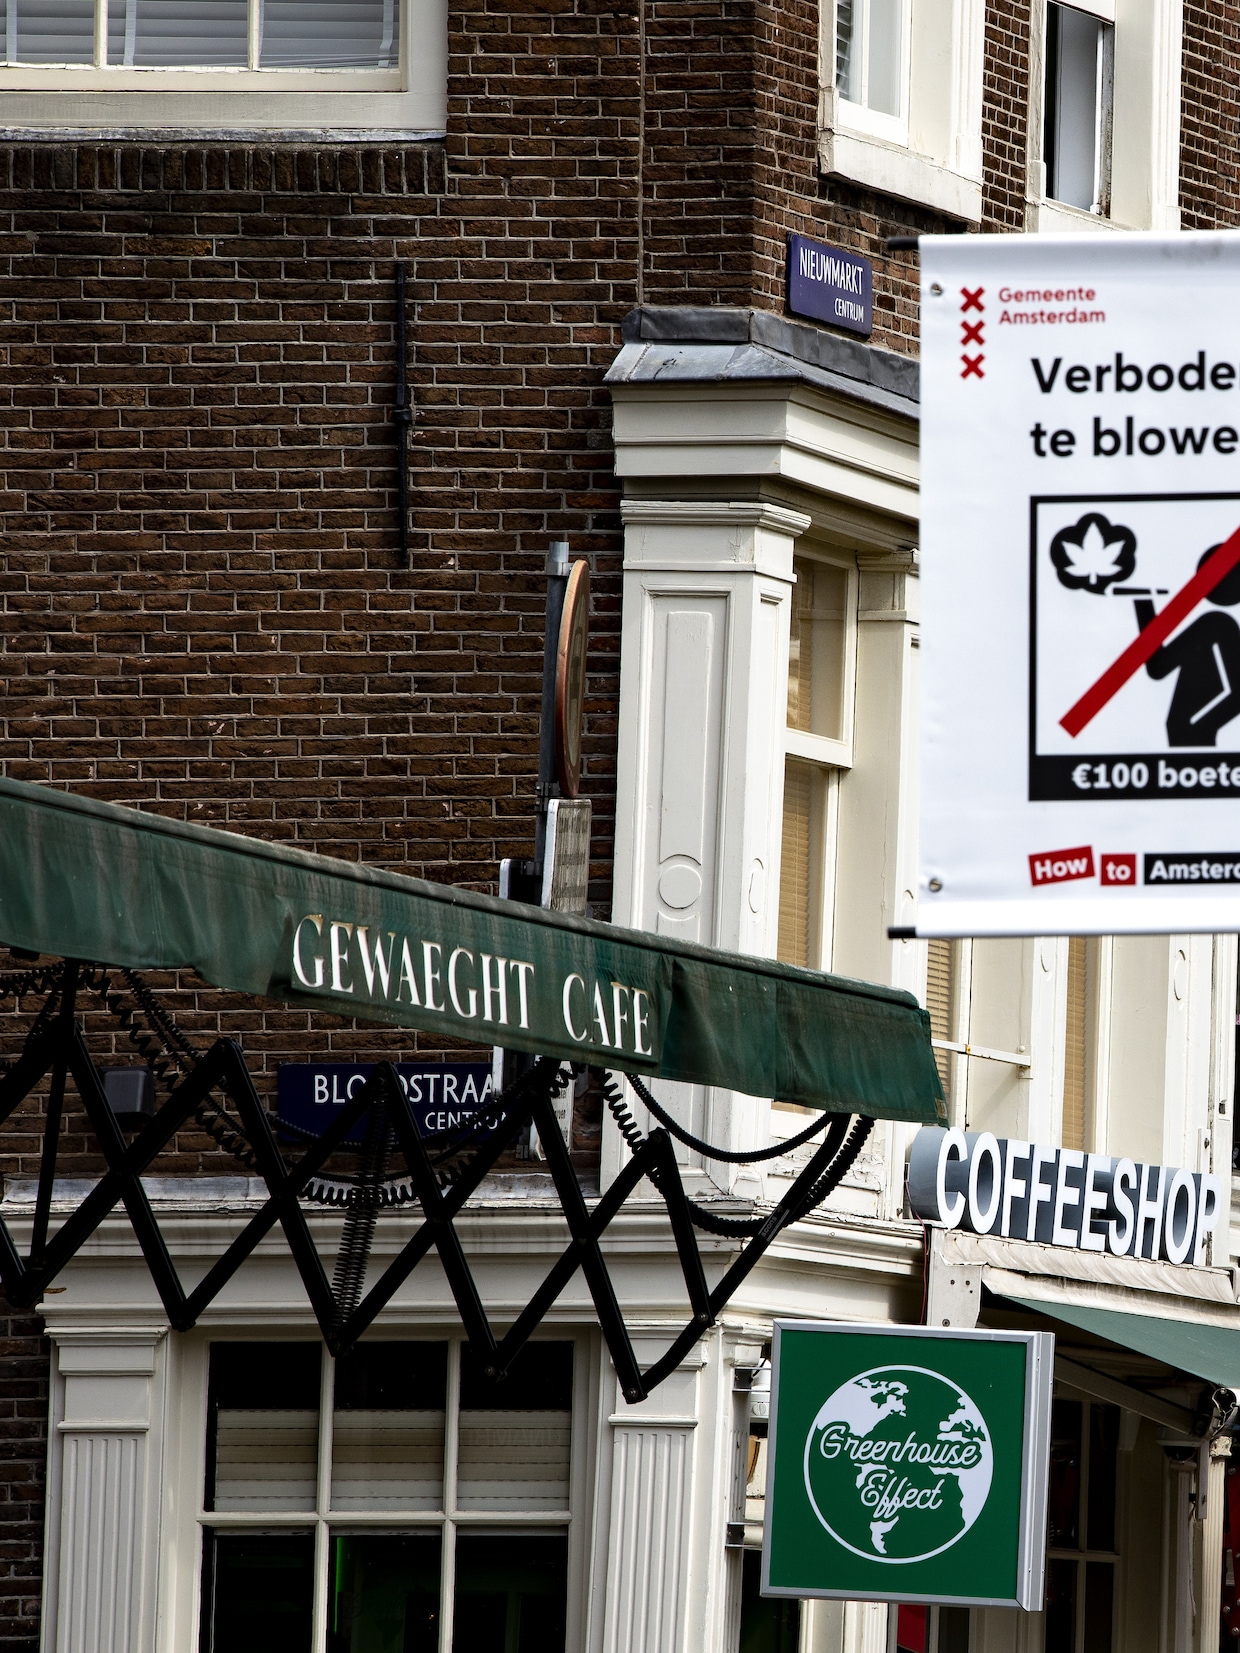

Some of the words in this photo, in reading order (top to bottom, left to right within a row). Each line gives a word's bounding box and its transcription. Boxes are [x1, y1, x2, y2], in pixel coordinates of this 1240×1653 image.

[799, 247, 864, 295] NIEUWMARKT
[834, 298, 864, 323] CENTRUM
[998, 286, 1097, 303] Gemeente
[998, 308, 1106, 325] Amsterdam
[1030, 421, 1077, 458] te
[1071, 763, 1150, 789] €100
[1033, 857, 1089, 880] How
[1105, 860, 1132, 881] to
[292, 913, 536, 1030] GEWAEGHT
[562, 972, 653, 1057] CAFE
[937, 1126, 1221, 1266] COFFEESHOP
[820, 1424, 979, 1466] Greenhouse
[860, 1473, 945, 1519] Effect
